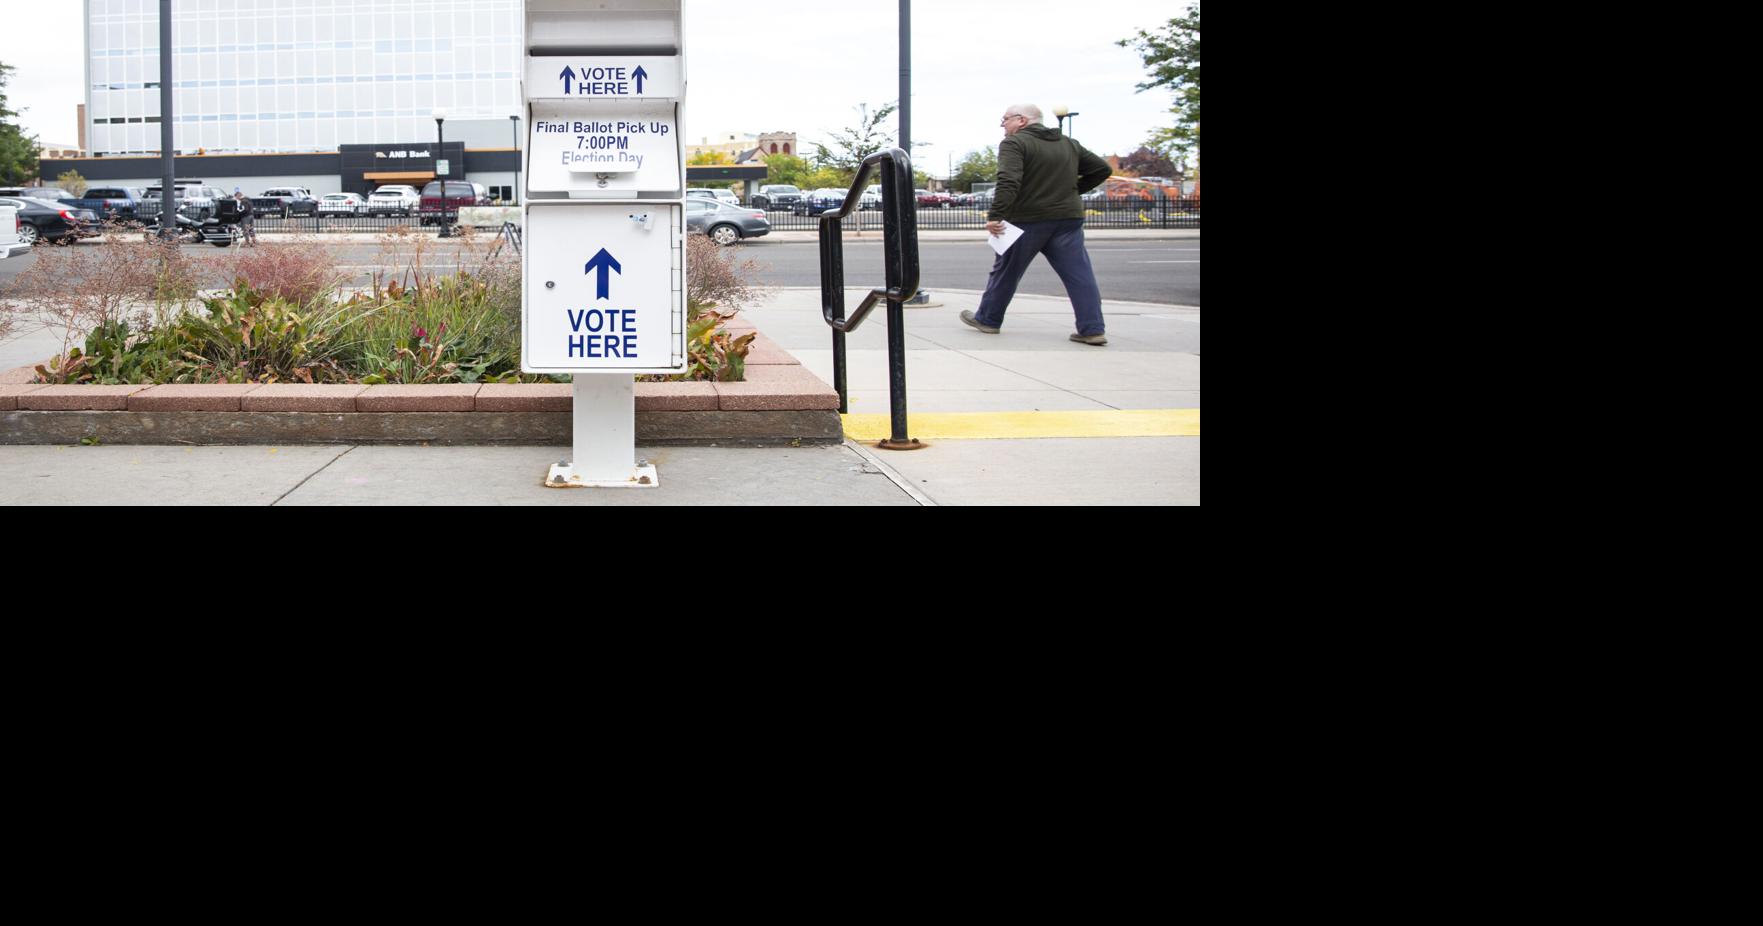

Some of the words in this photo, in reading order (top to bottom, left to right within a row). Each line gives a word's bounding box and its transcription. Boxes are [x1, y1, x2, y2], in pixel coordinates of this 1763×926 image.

[581, 67, 626, 80] VOTE
[579, 82, 628, 95] HERE
[536, 121, 569, 133] Final
[573, 121, 613, 133] Ballot
[617, 122, 646, 133] Pick
[650, 122, 669, 136] Up
[577, 135, 628, 149] 7:00PM
[388, 150, 407, 158] ANB
[409, 150, 431, 158] Bank
[562, 151, 614, 165] Election
[619, 151, 643, 169] Day
[567, 309, 637, 332] VOTE
[568, 334, 638, 357] HERE
